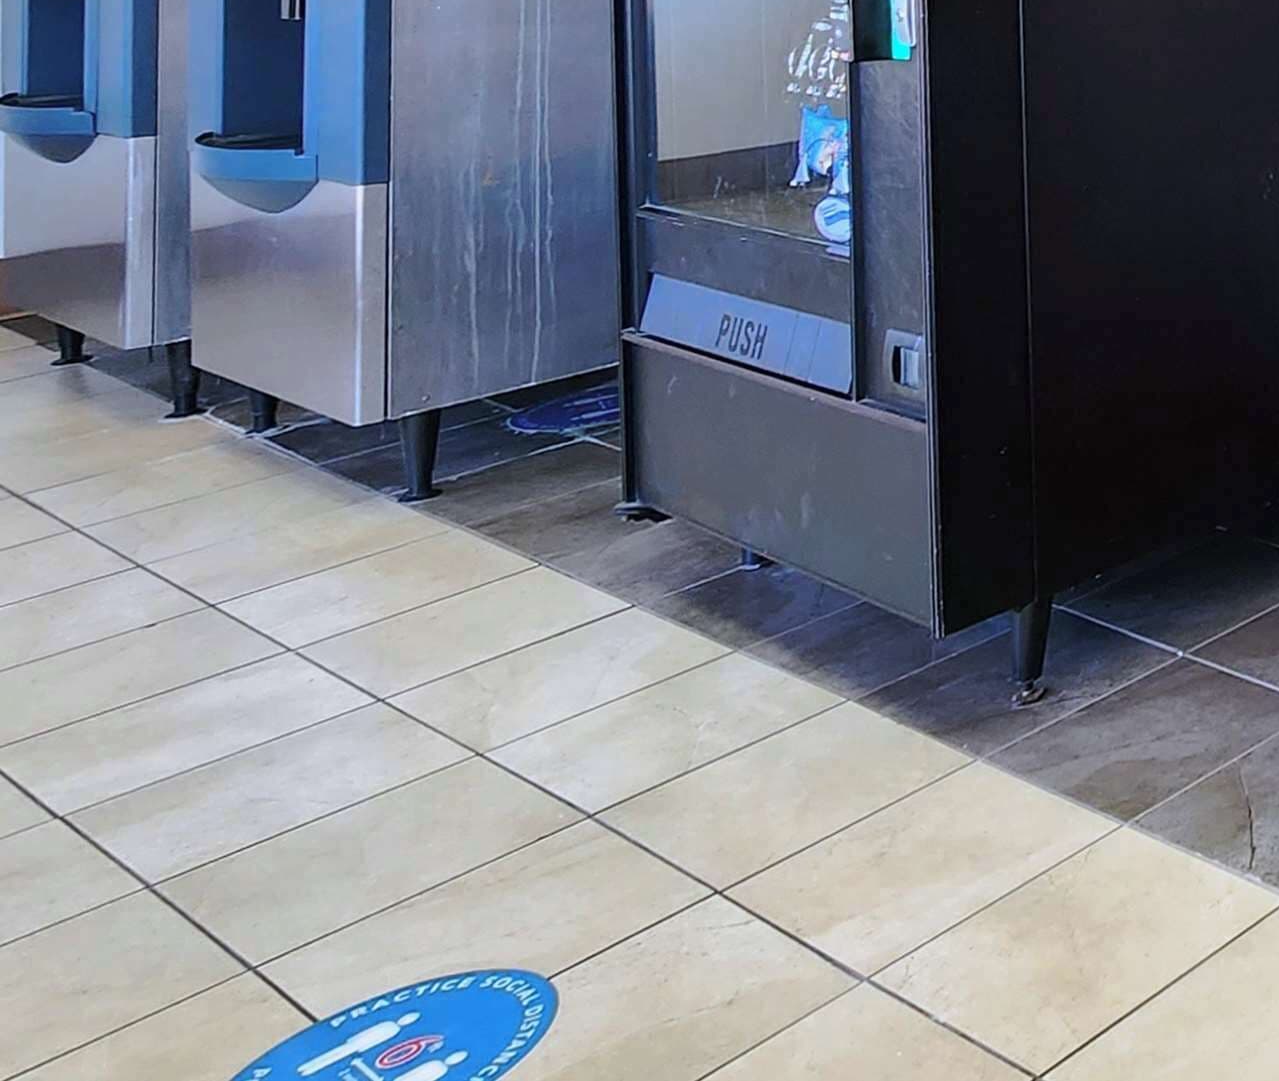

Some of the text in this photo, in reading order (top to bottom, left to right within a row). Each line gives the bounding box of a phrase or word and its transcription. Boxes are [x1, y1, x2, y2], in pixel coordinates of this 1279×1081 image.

[715, 314, 768, 360] PUSH
[330, 975, 479, 1028] PRACTICE
[479, 976, 541, 1006] SOCIAL
